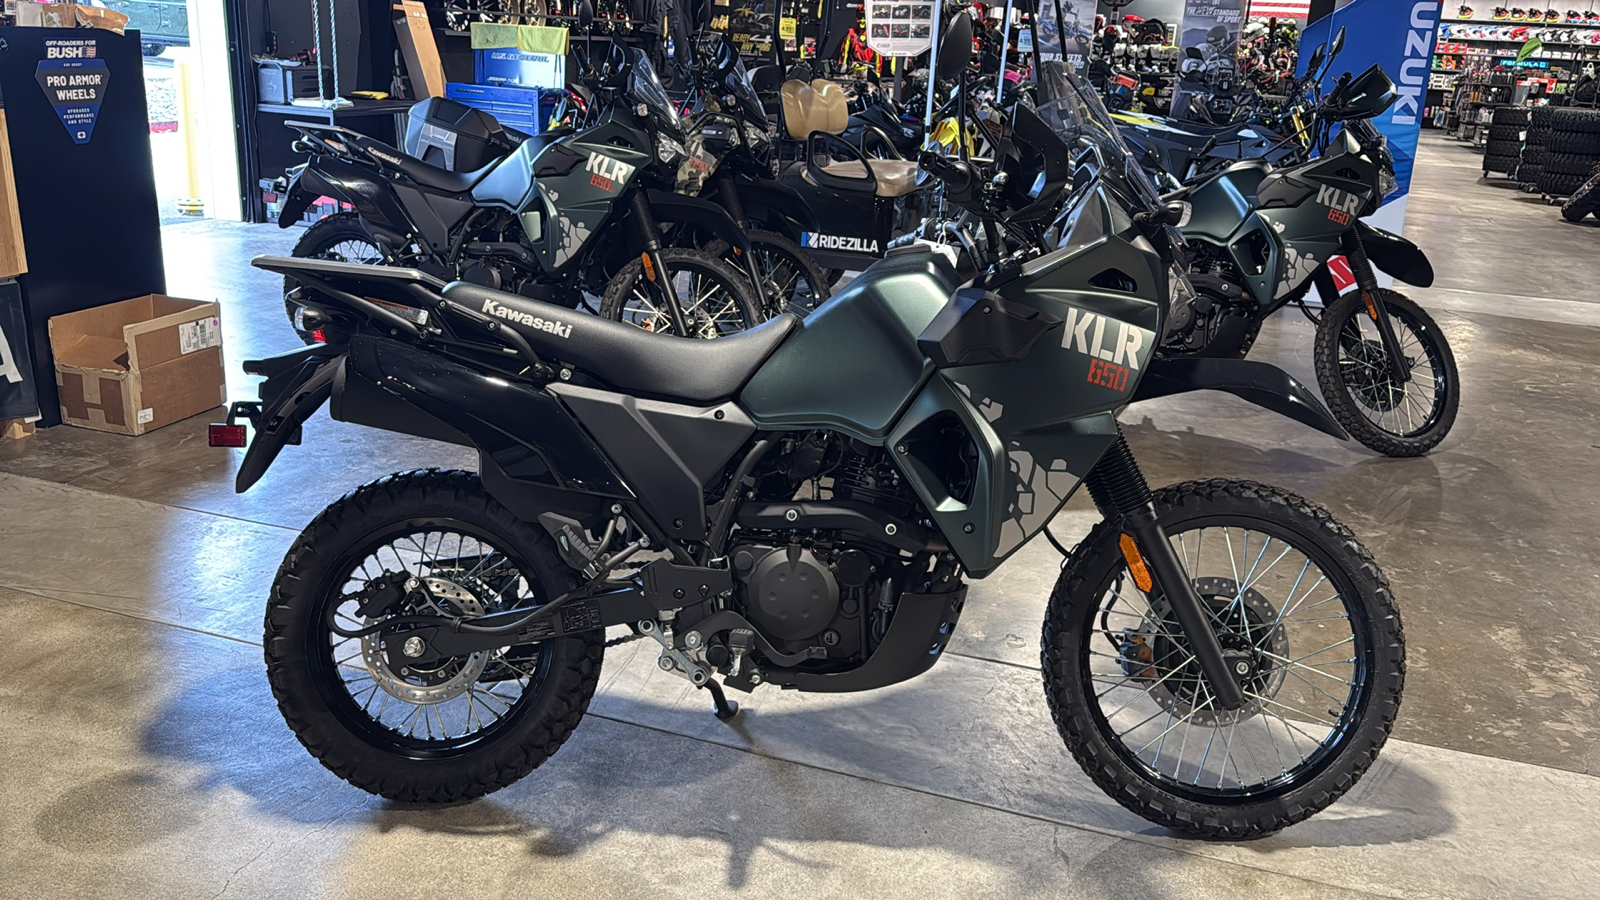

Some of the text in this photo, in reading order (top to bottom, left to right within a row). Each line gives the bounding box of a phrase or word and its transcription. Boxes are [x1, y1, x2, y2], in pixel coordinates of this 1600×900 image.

[47, 47, 82, 58] BUSH
[46, 74, 101, 87] PRO ARMOR
[56, 88, 96, 100] WHEELS
[367, 146, 403, 165] Kawasaki
[585, 151, 628, 185] KLR
[590, 174, 613, 193] 650
[1316, 183, 1359, 217] KLR
[1327, 208, 1350, 226] 650
[819, 234, 879, 253] RIDEZILLA
[481, 298, 573, 339] Kawasaki
[1061, 306, 1143, 371] KLR
[1086, 358, 1130, 393] 650
